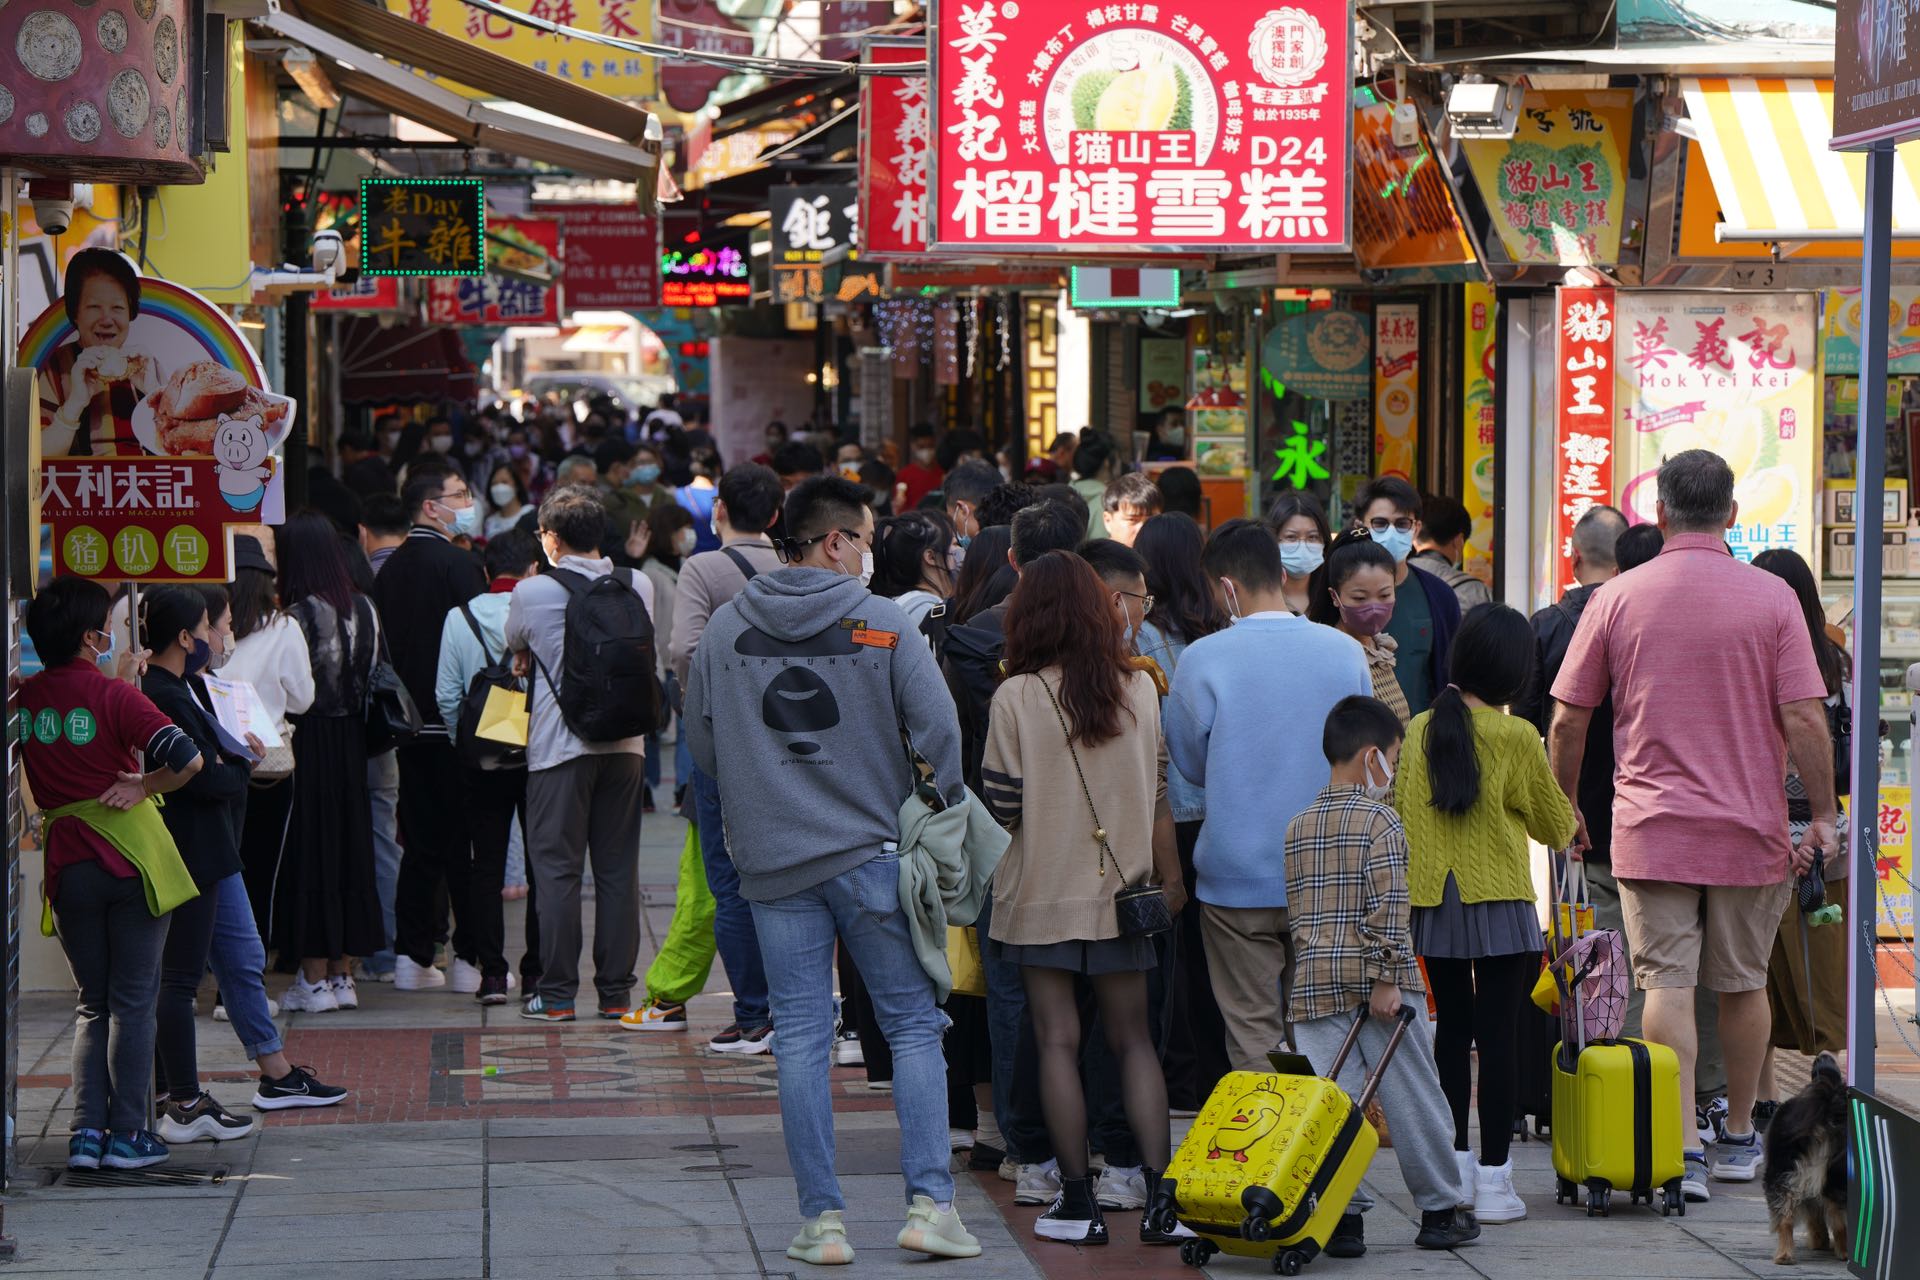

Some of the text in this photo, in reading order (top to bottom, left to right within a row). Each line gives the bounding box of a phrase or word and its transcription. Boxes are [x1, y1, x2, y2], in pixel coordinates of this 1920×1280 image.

[1085, 3, 1159, 29] 楊枝甘露
[1170, 14, 1230, 72] 芒果雪糕
[1271, 25, 1304, 39] 澳門
[1271, 40, 1304, 54] 獨家
[1027, 23, 1076, 88] 木糠布丁
[1271, 55, 1304, 69] 始創
[947, 1, 1008, 162] 莫義記
[1259, 90, 1314, 104] 老字號
[1018, 99, 1041, 154] 大菜糕
[1221, 79, 1244, 155] 咖啡奶茶
[1253, 108, 1321, 121] 始於1935年
[1074, 131, 1192, 165] 猫山王
[1251, 136, 1327, 165] D24
[371, 218, 475, 269] 牛雜
[1762, 268, 1775, 287] 3
[1624, 316, 1797, 371] 莫義記
[1640, 373, 1788, 388] Mok Yei Kei
[1272, 420, 1330, 490] 永
[41, 465, 195, 509] 大利來記
[888, 636, 897, 648] 2
